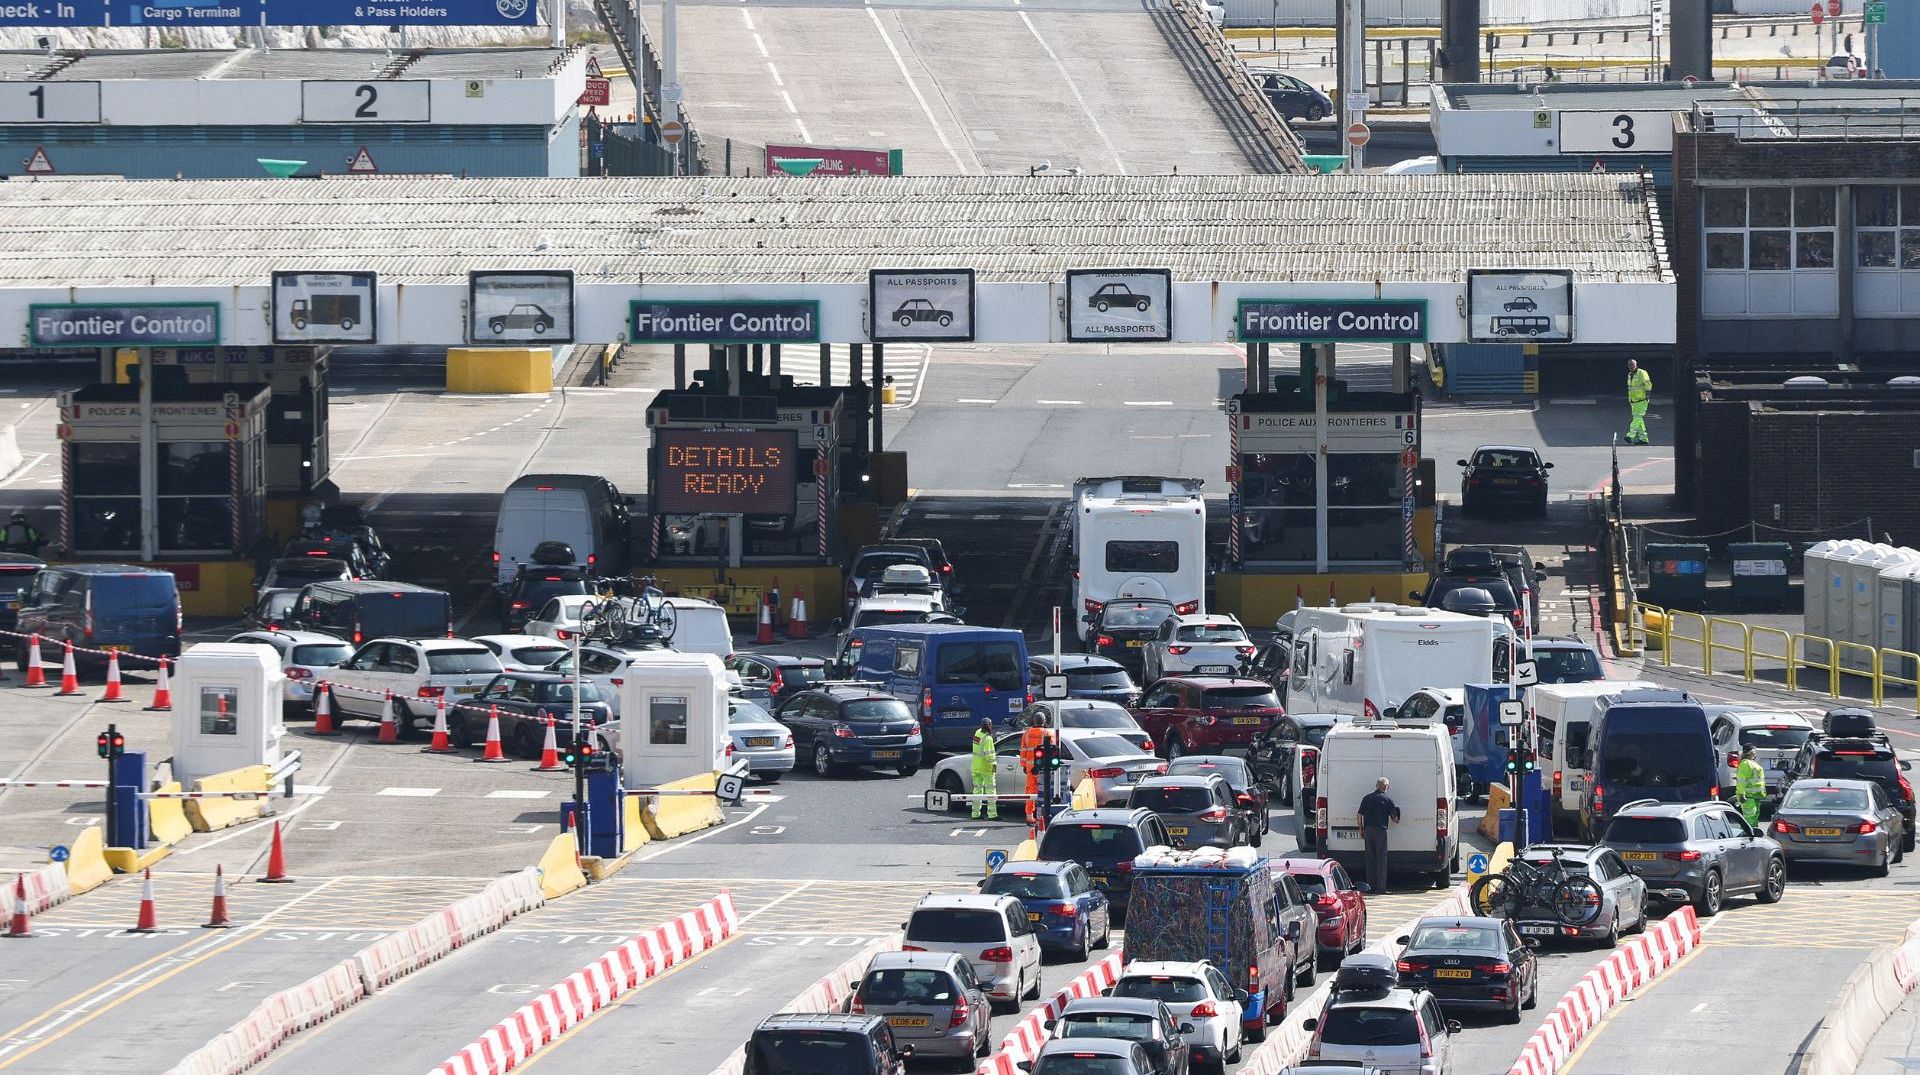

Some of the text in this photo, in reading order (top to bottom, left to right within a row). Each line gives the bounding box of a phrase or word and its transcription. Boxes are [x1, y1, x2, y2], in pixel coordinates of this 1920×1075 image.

[57, 3, 75, 18] In
[144, 7, 241, 21] Cargo Terminal
[354, 6, 448, 17] & Pass Holders
[29, 85, 45, 119] 1
[355, 84, 378, 118] 2
[1611, 115, 1635, 149] 3
[887, 278, 957, 286] ALL PASSPORTS
[37, 315, 212, 336] Frontier Control
[638, 312, 811, 332] Frontier Control
[1246, 311, 1418, 331] Frontier Control
[1103, 325, 1155, 333] PASSPORTS
[227, 394, 237, 406] 2
[88, 407, 127, 416] POLICE
[1229, 401, 1237, 413] 5
[1258, 418, 1295, 427] POLICE
[1328, 418, 1386, 427] RONTIERES
[817, 427, 825, 440] 4
[1405, 431, 1413, 444] 6
[668, 446, 781, 468] DETAILS
[684, 473, 766, 494] READY
[1519, 668, 1531, 678] K
[724, 782, 735, 793] G
[932, 795, 943, 806] H
[1438, 969, 1454, 978] YS17
[911, 1017, 925, 1026] ACY
